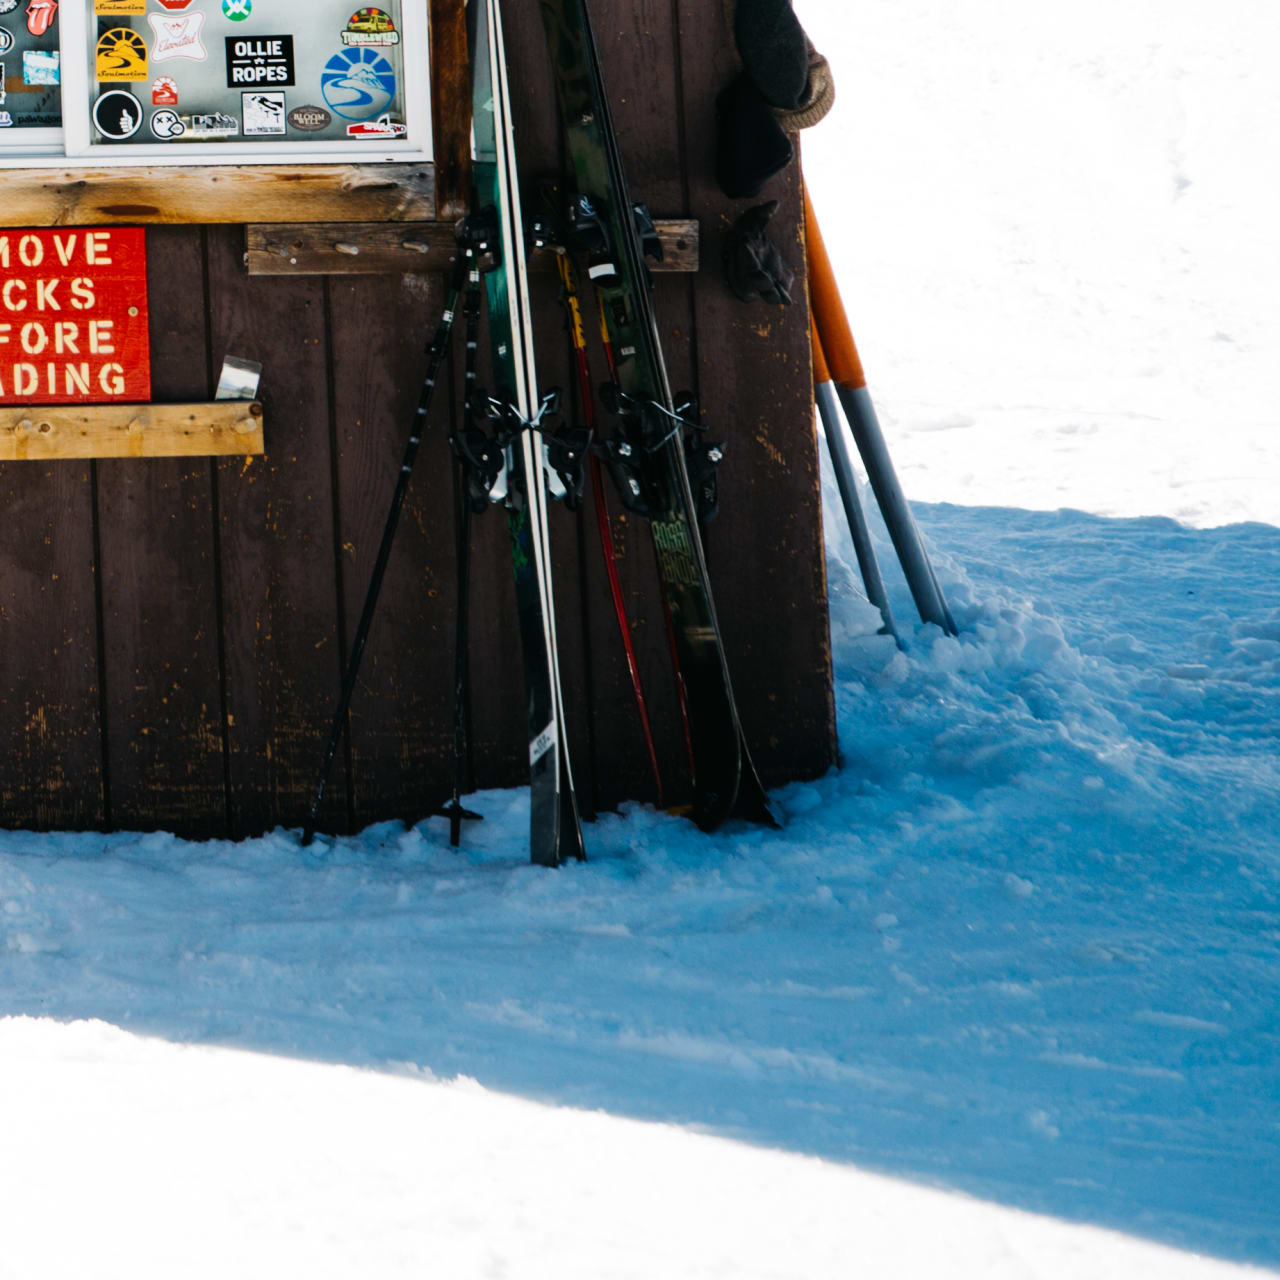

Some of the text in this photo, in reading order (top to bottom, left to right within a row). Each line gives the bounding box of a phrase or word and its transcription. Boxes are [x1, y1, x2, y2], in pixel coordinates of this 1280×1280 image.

[235, 40, 283, 57] OLLIE
[233, 66, 287, 83] ROPES
[293, 113, 325, 121] BLOOM
